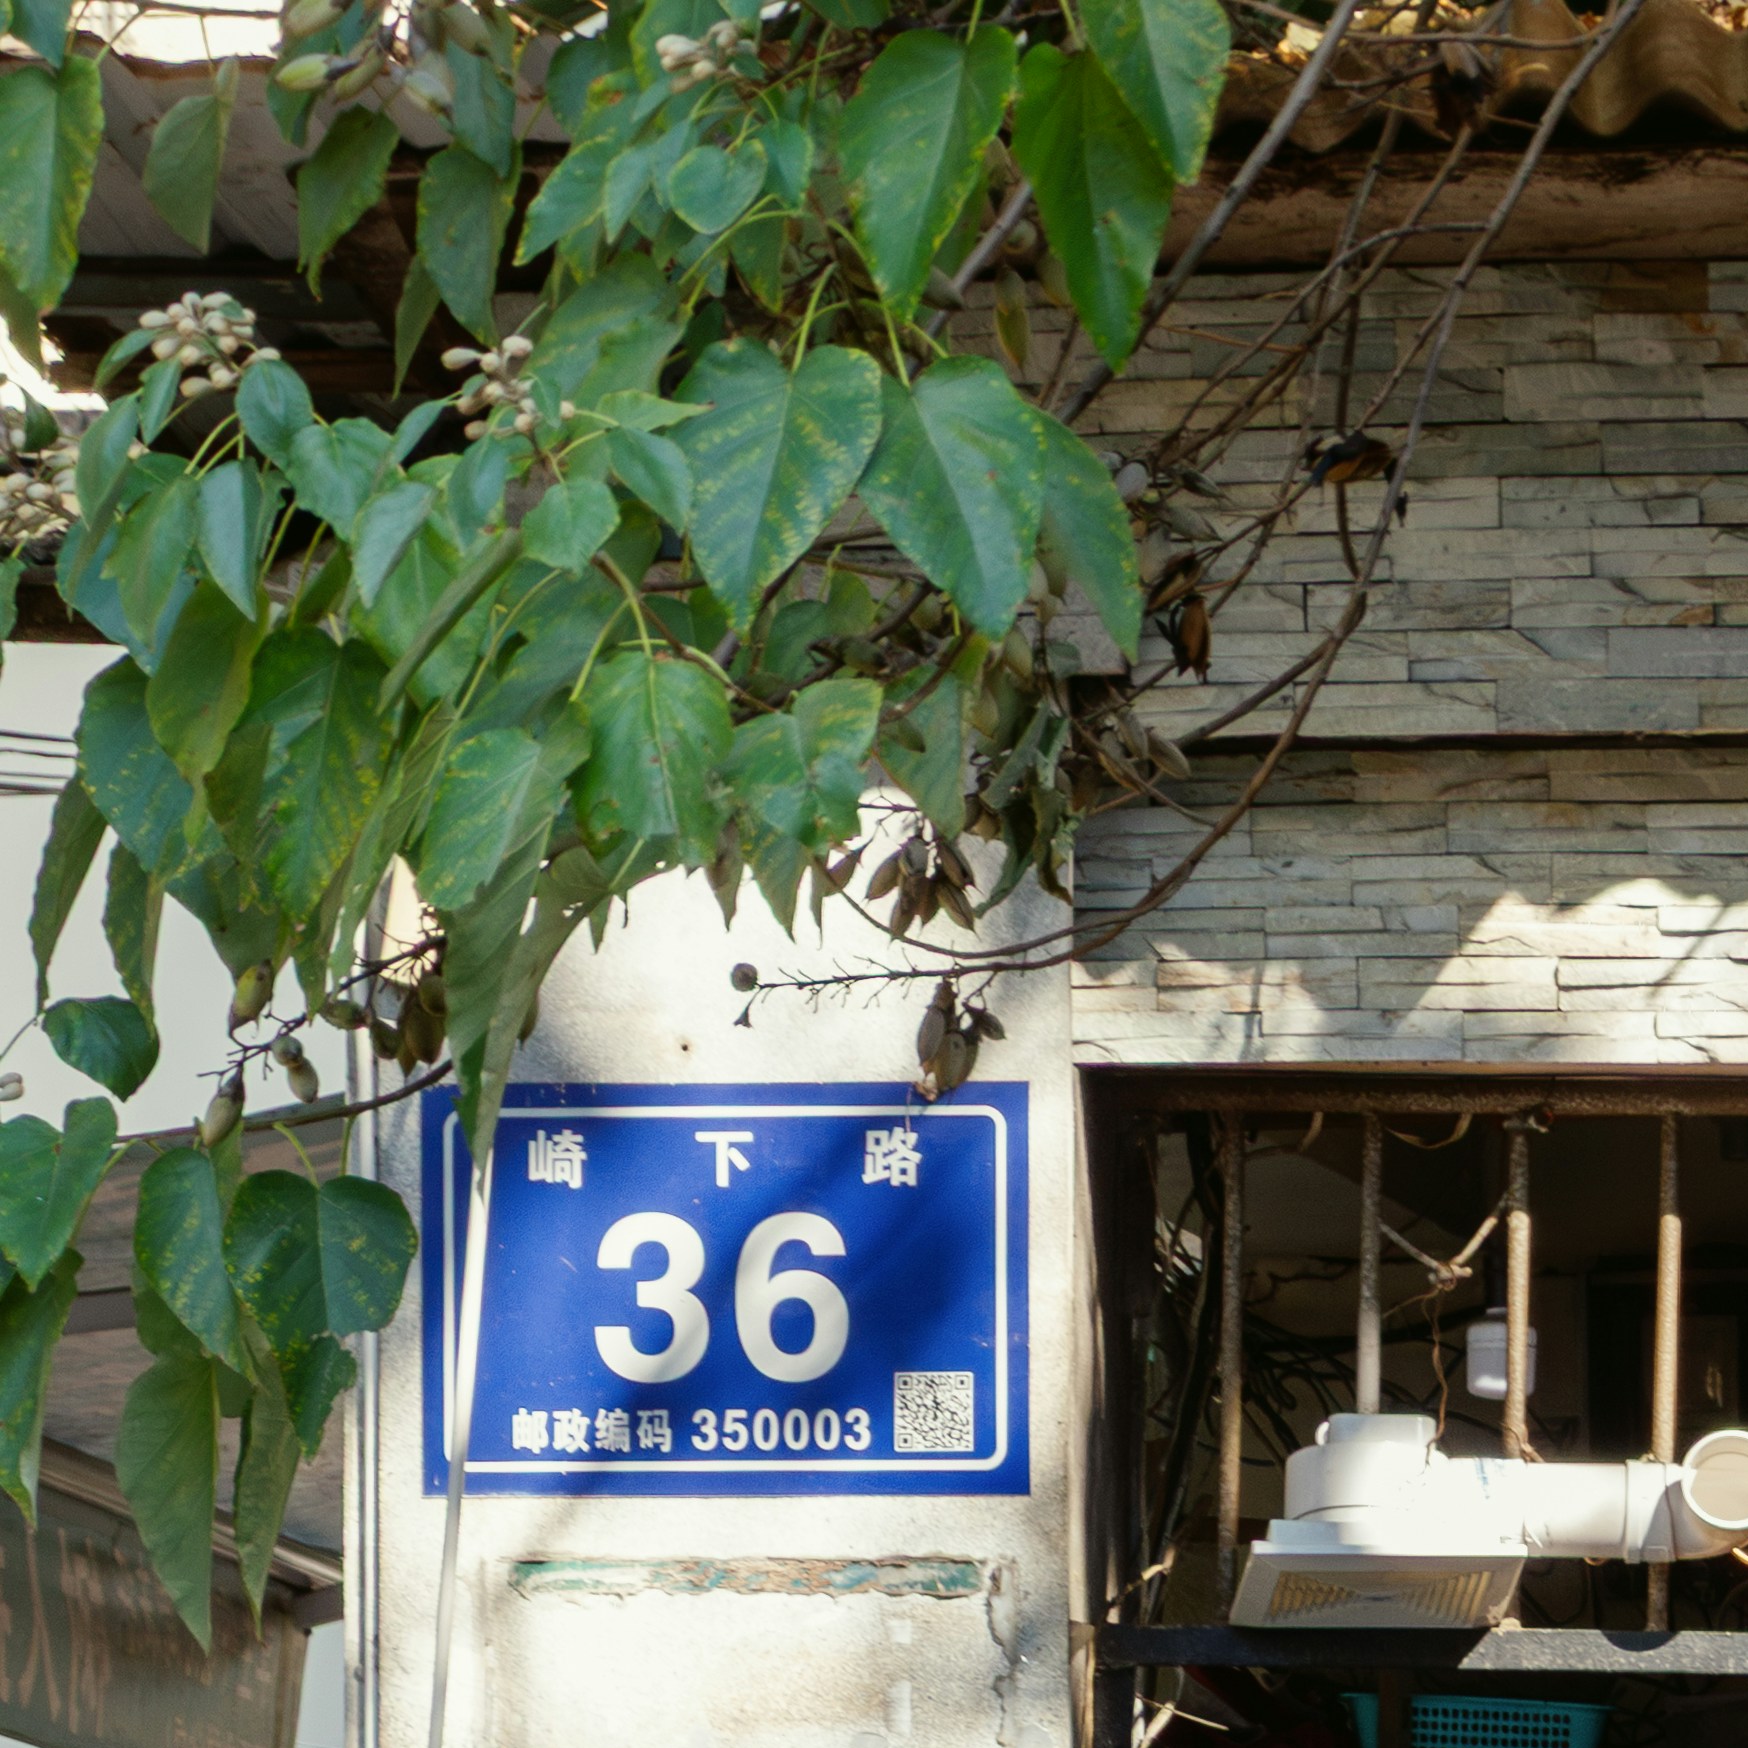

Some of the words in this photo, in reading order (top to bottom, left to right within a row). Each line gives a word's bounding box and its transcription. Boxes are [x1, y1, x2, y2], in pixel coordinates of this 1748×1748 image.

[527, 1127, 924, 1189] 崎下路
[594, 1211, 851, 1384] 36
[511, 1407, 673, 1454] 邮政编码
[691, 1408, 872, 1452] 350003
